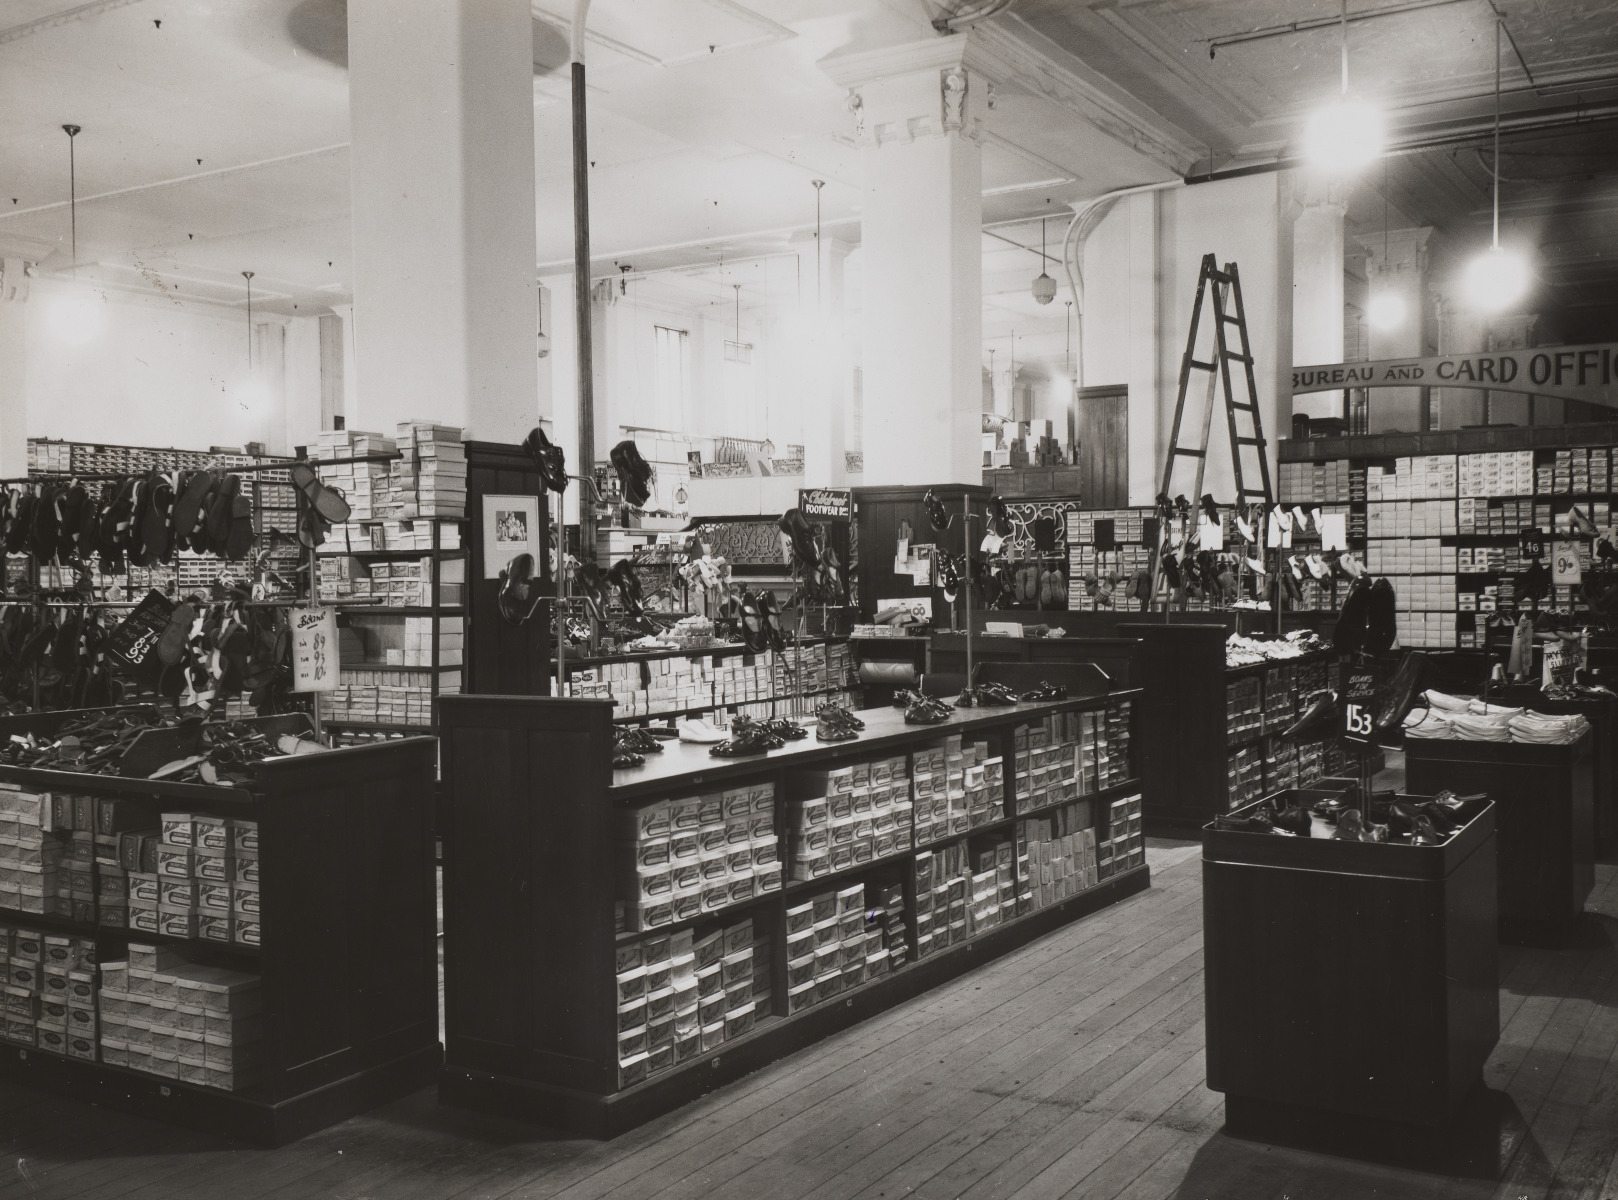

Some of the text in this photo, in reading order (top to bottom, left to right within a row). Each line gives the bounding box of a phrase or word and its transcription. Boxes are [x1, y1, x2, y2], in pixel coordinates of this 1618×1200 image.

[1384, 365, 1425, 380] AND
[1436, 356, 1518, 384] CARD
[806, 504, 838, 515] FOOTWEAR
